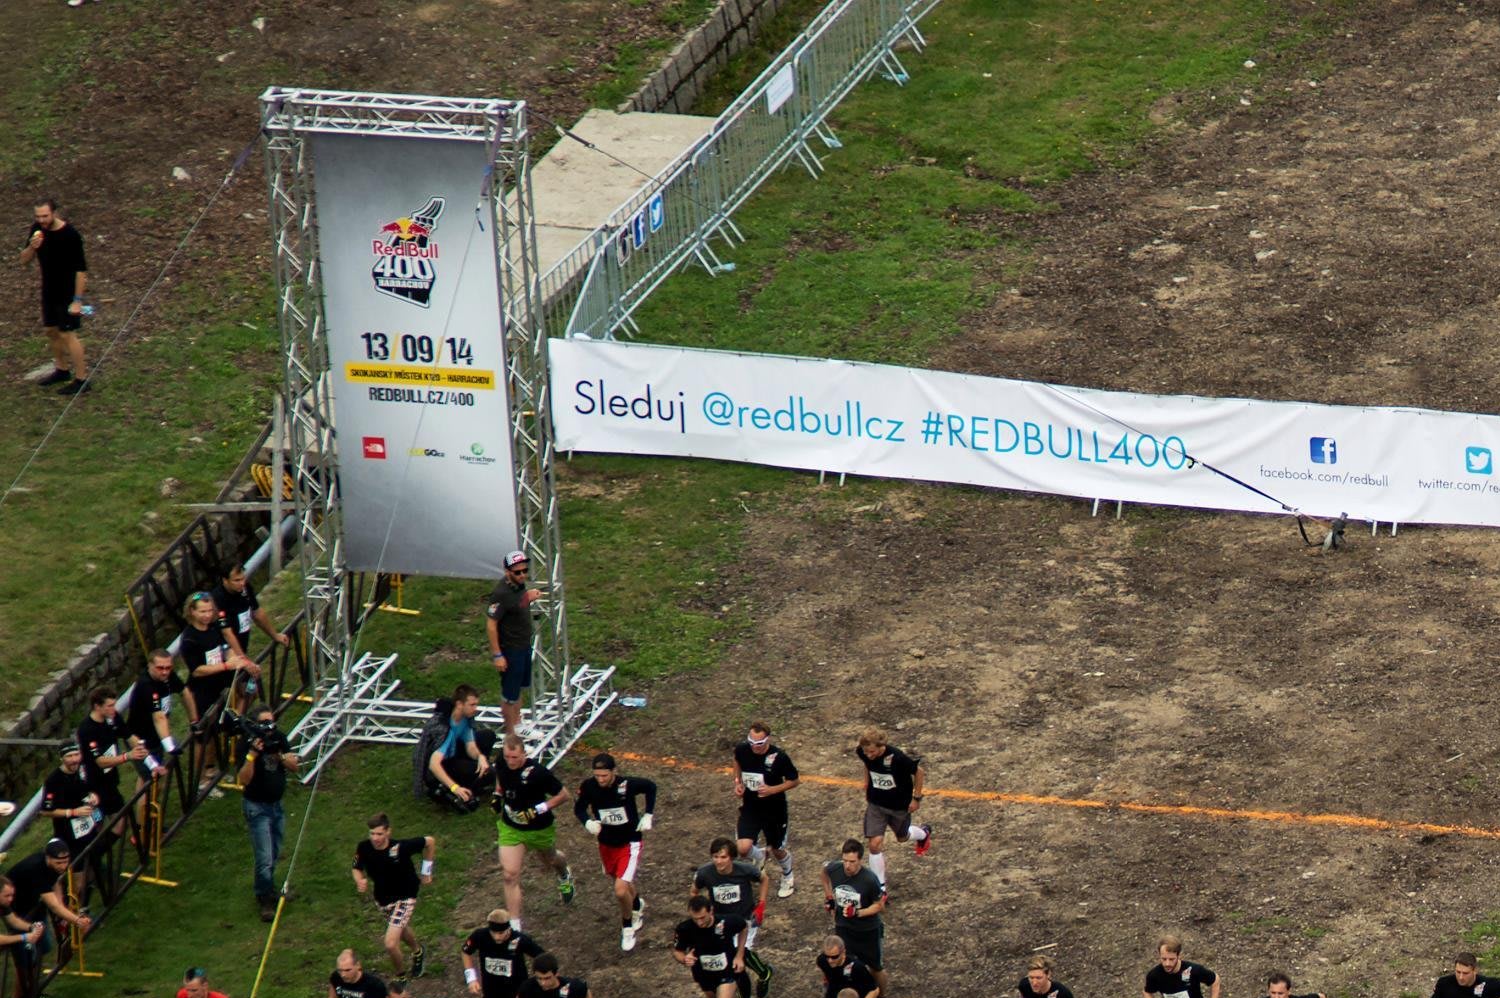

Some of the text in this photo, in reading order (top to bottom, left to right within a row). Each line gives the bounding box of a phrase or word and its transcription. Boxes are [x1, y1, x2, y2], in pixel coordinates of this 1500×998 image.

[373, 240, 439, 258] Red Bull
[374, 256, 434, 280] 400
[378, 279, 430, 289] HARRACHOV
[447, 375, 490, 385] HARRACHOV
[369, 387, 475, 406] REDBULL.CZ/400
[574, 379, 1187, 470] Sleduj @redbullcz #REDBULL400
[1260, 465, 1389, 487] facebook.com/redbull
